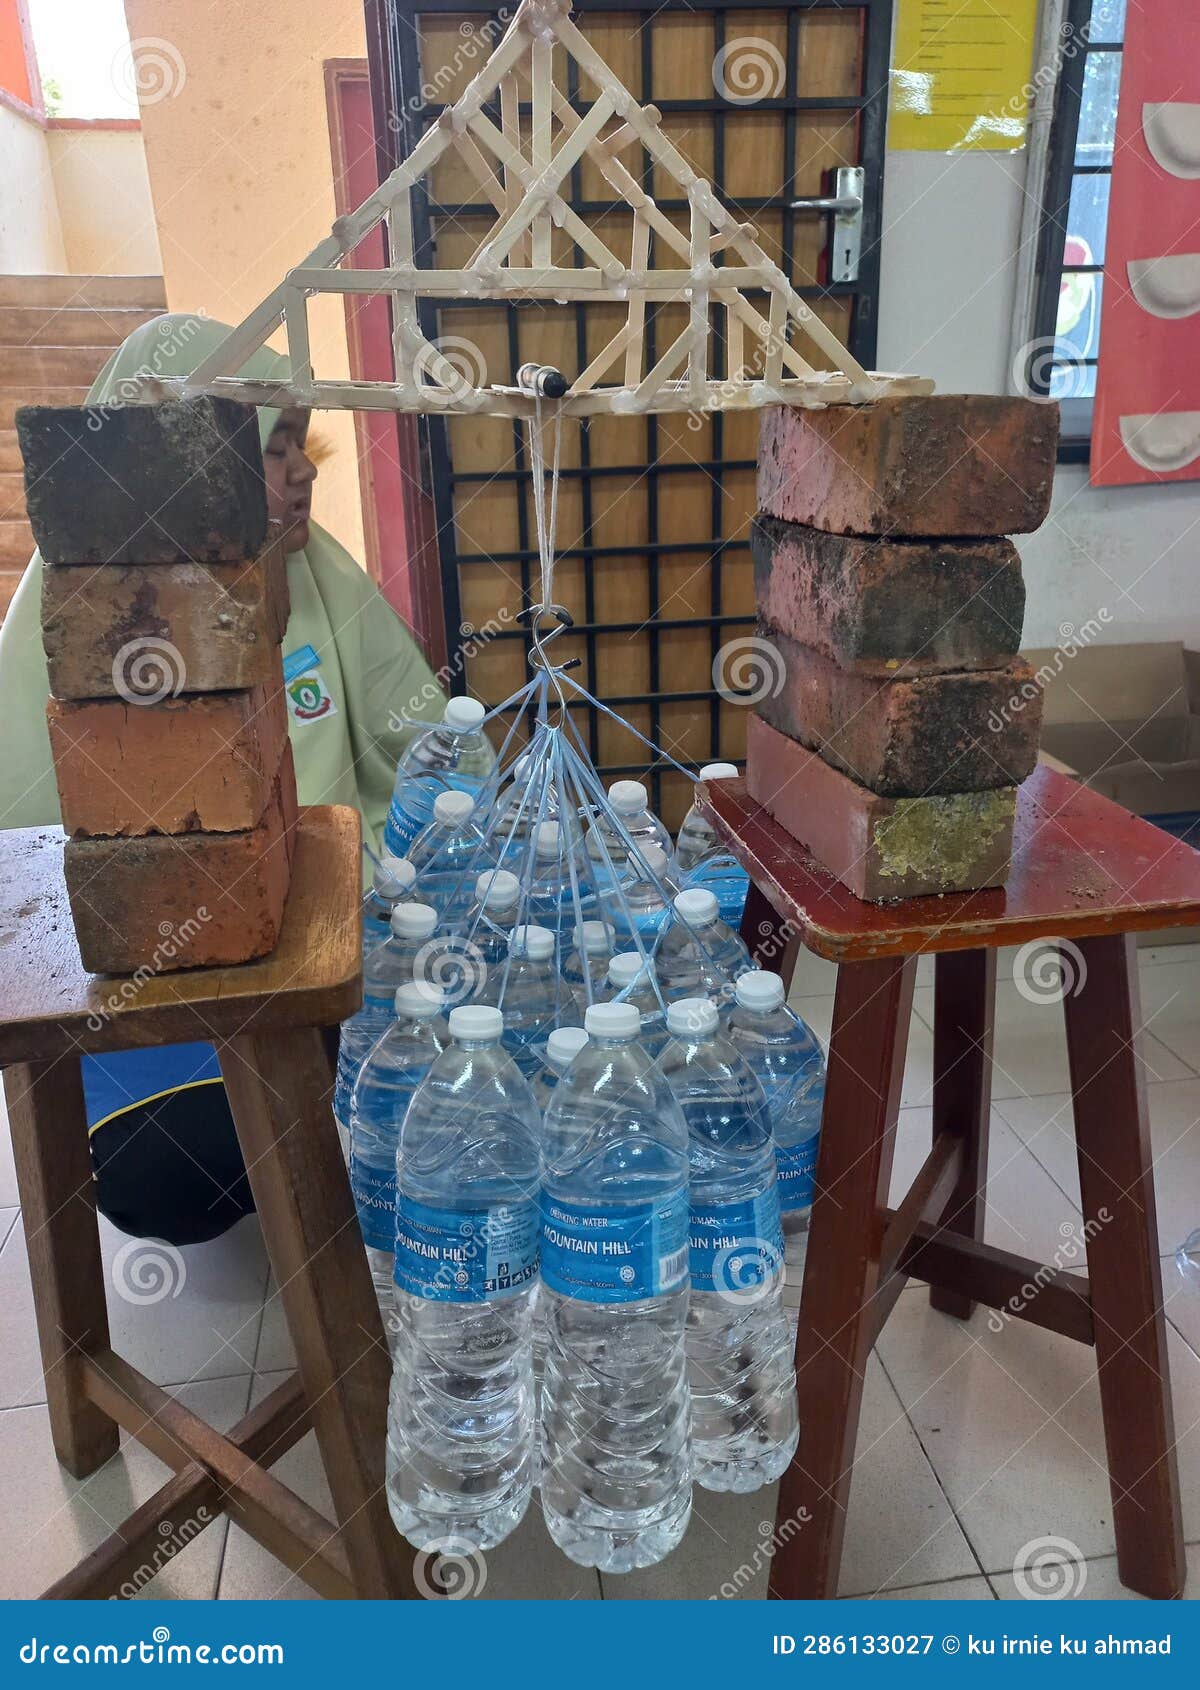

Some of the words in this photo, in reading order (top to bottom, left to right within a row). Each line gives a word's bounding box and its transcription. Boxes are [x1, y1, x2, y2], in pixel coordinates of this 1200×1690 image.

[582, 1217, 609, 1228] WATER
[544, 1225, 598, 1255] MOUNTAIN
[603, 1241, 631, 1255] HILL
[713, 1235, 740, 1249] HILL
[443, 1247, 468, 1261] HILL
